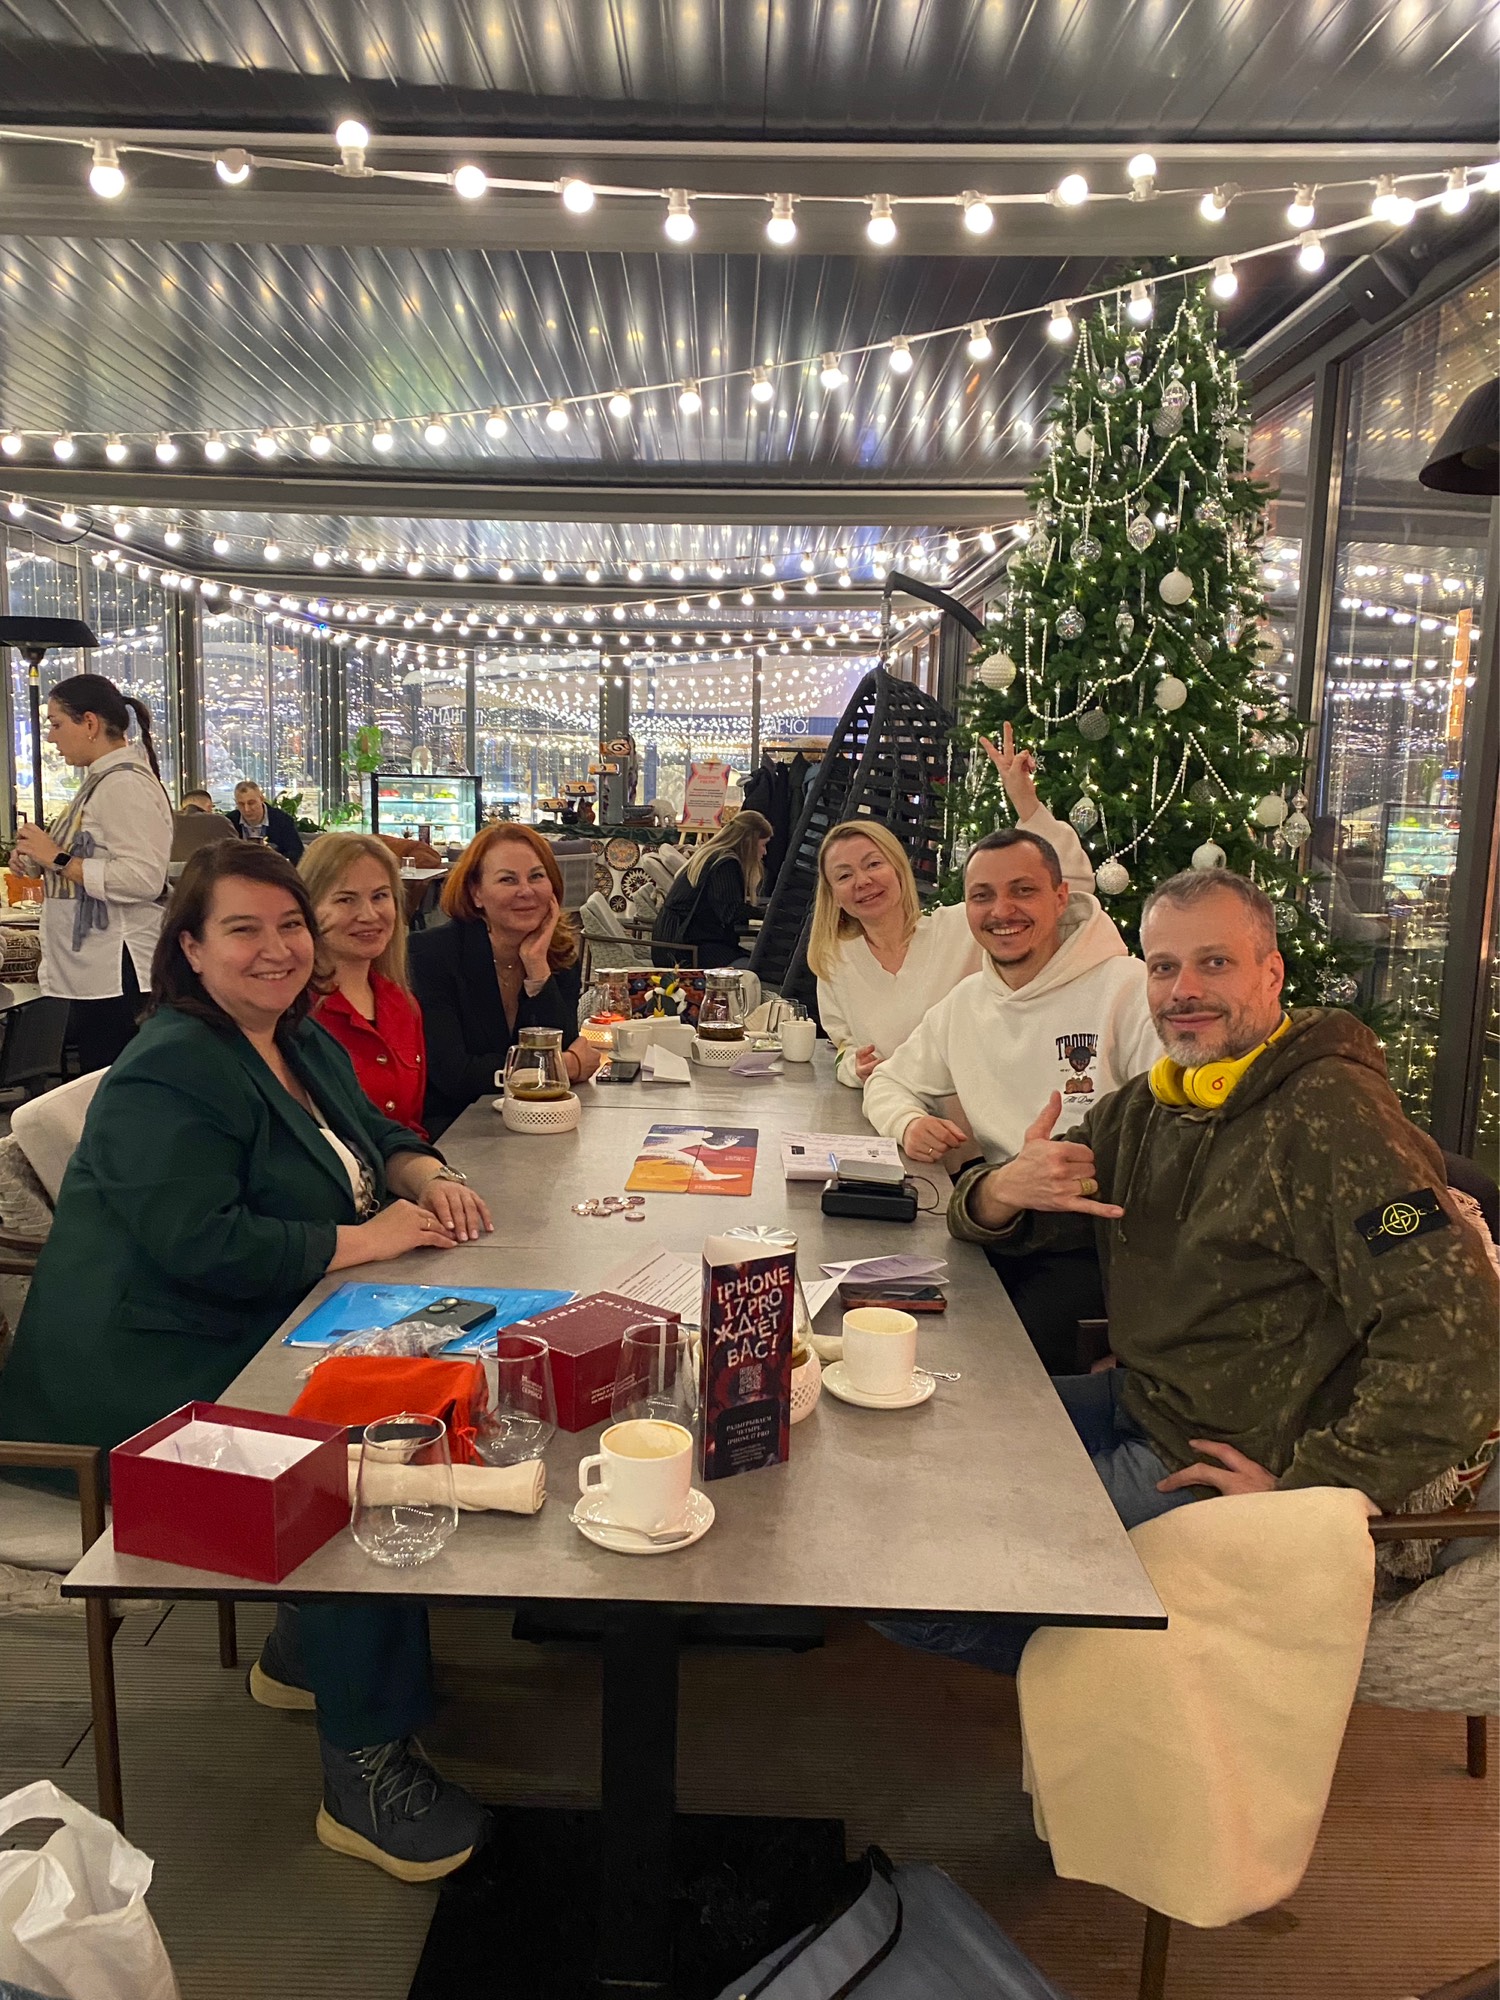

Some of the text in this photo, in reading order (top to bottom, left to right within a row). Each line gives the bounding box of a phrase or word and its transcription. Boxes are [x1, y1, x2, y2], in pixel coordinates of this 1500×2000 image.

[432, 708, 484, 725] МАНГЛ
[724, 1297, 746, 1321] 17
[747, 1287, 783, 1317] PRO
[713, 1309, 781, 1345] ЖДЁТ
[727, 1334, 779, 1367] ВАС!
[757, 1430, 770, 1438] PRO
